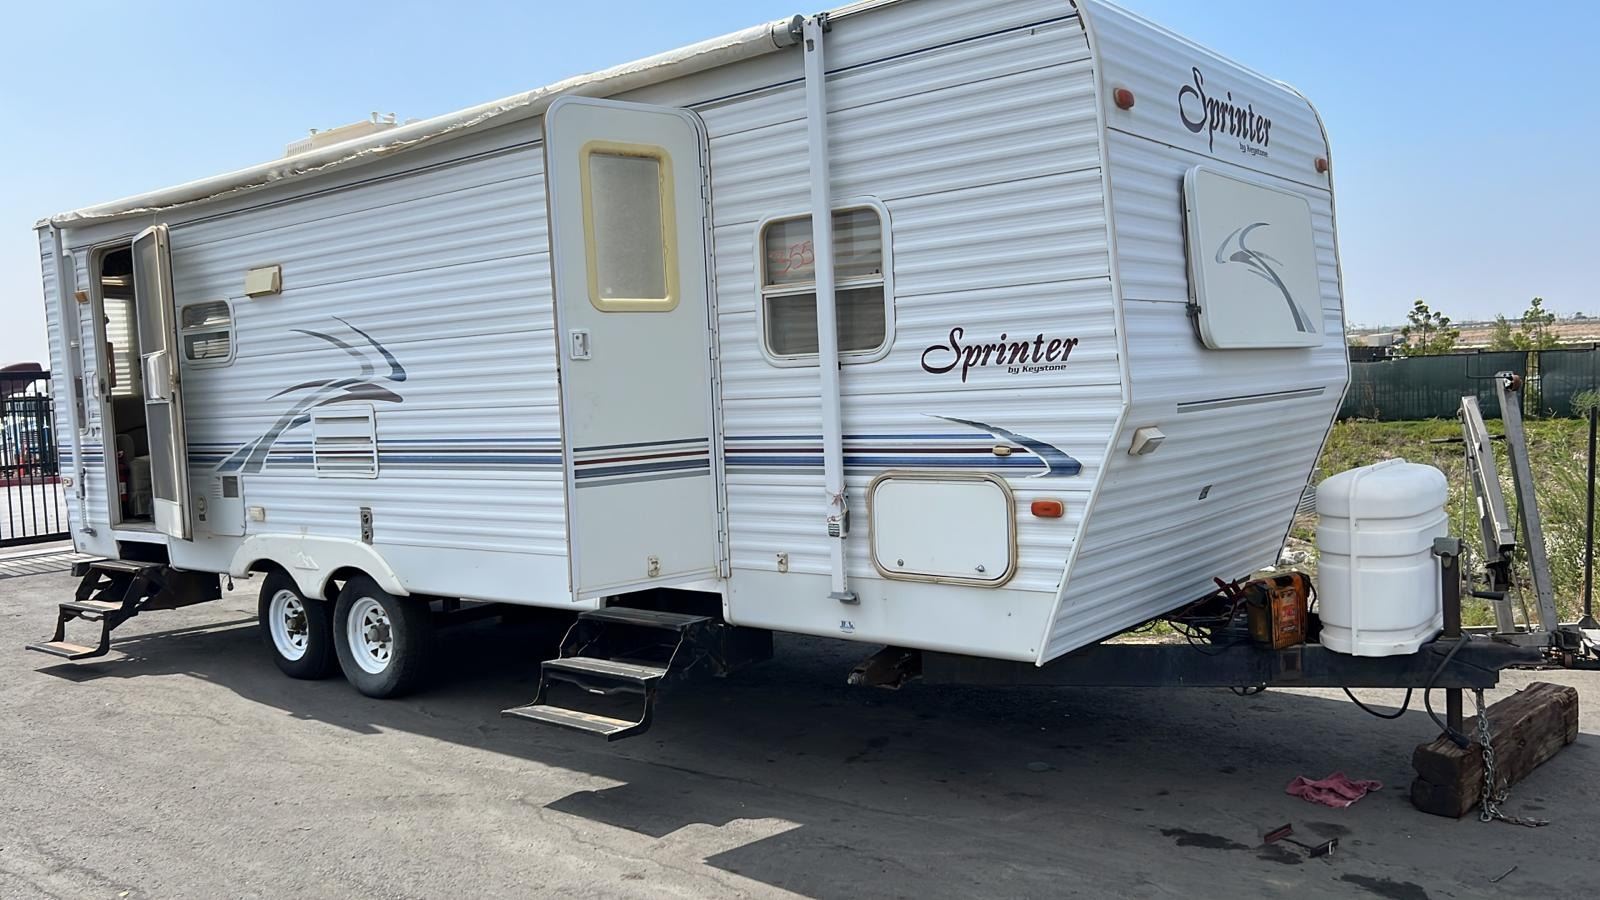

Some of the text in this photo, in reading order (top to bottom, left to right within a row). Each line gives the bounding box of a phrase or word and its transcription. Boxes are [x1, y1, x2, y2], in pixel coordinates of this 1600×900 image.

[1178, 66, 1271, 153] Sprinter
[1239, 142, 1247, 153] by
[921, 327, 1079, 383] Sprinter
[1008, 364, 1067, 375] by Keystone
